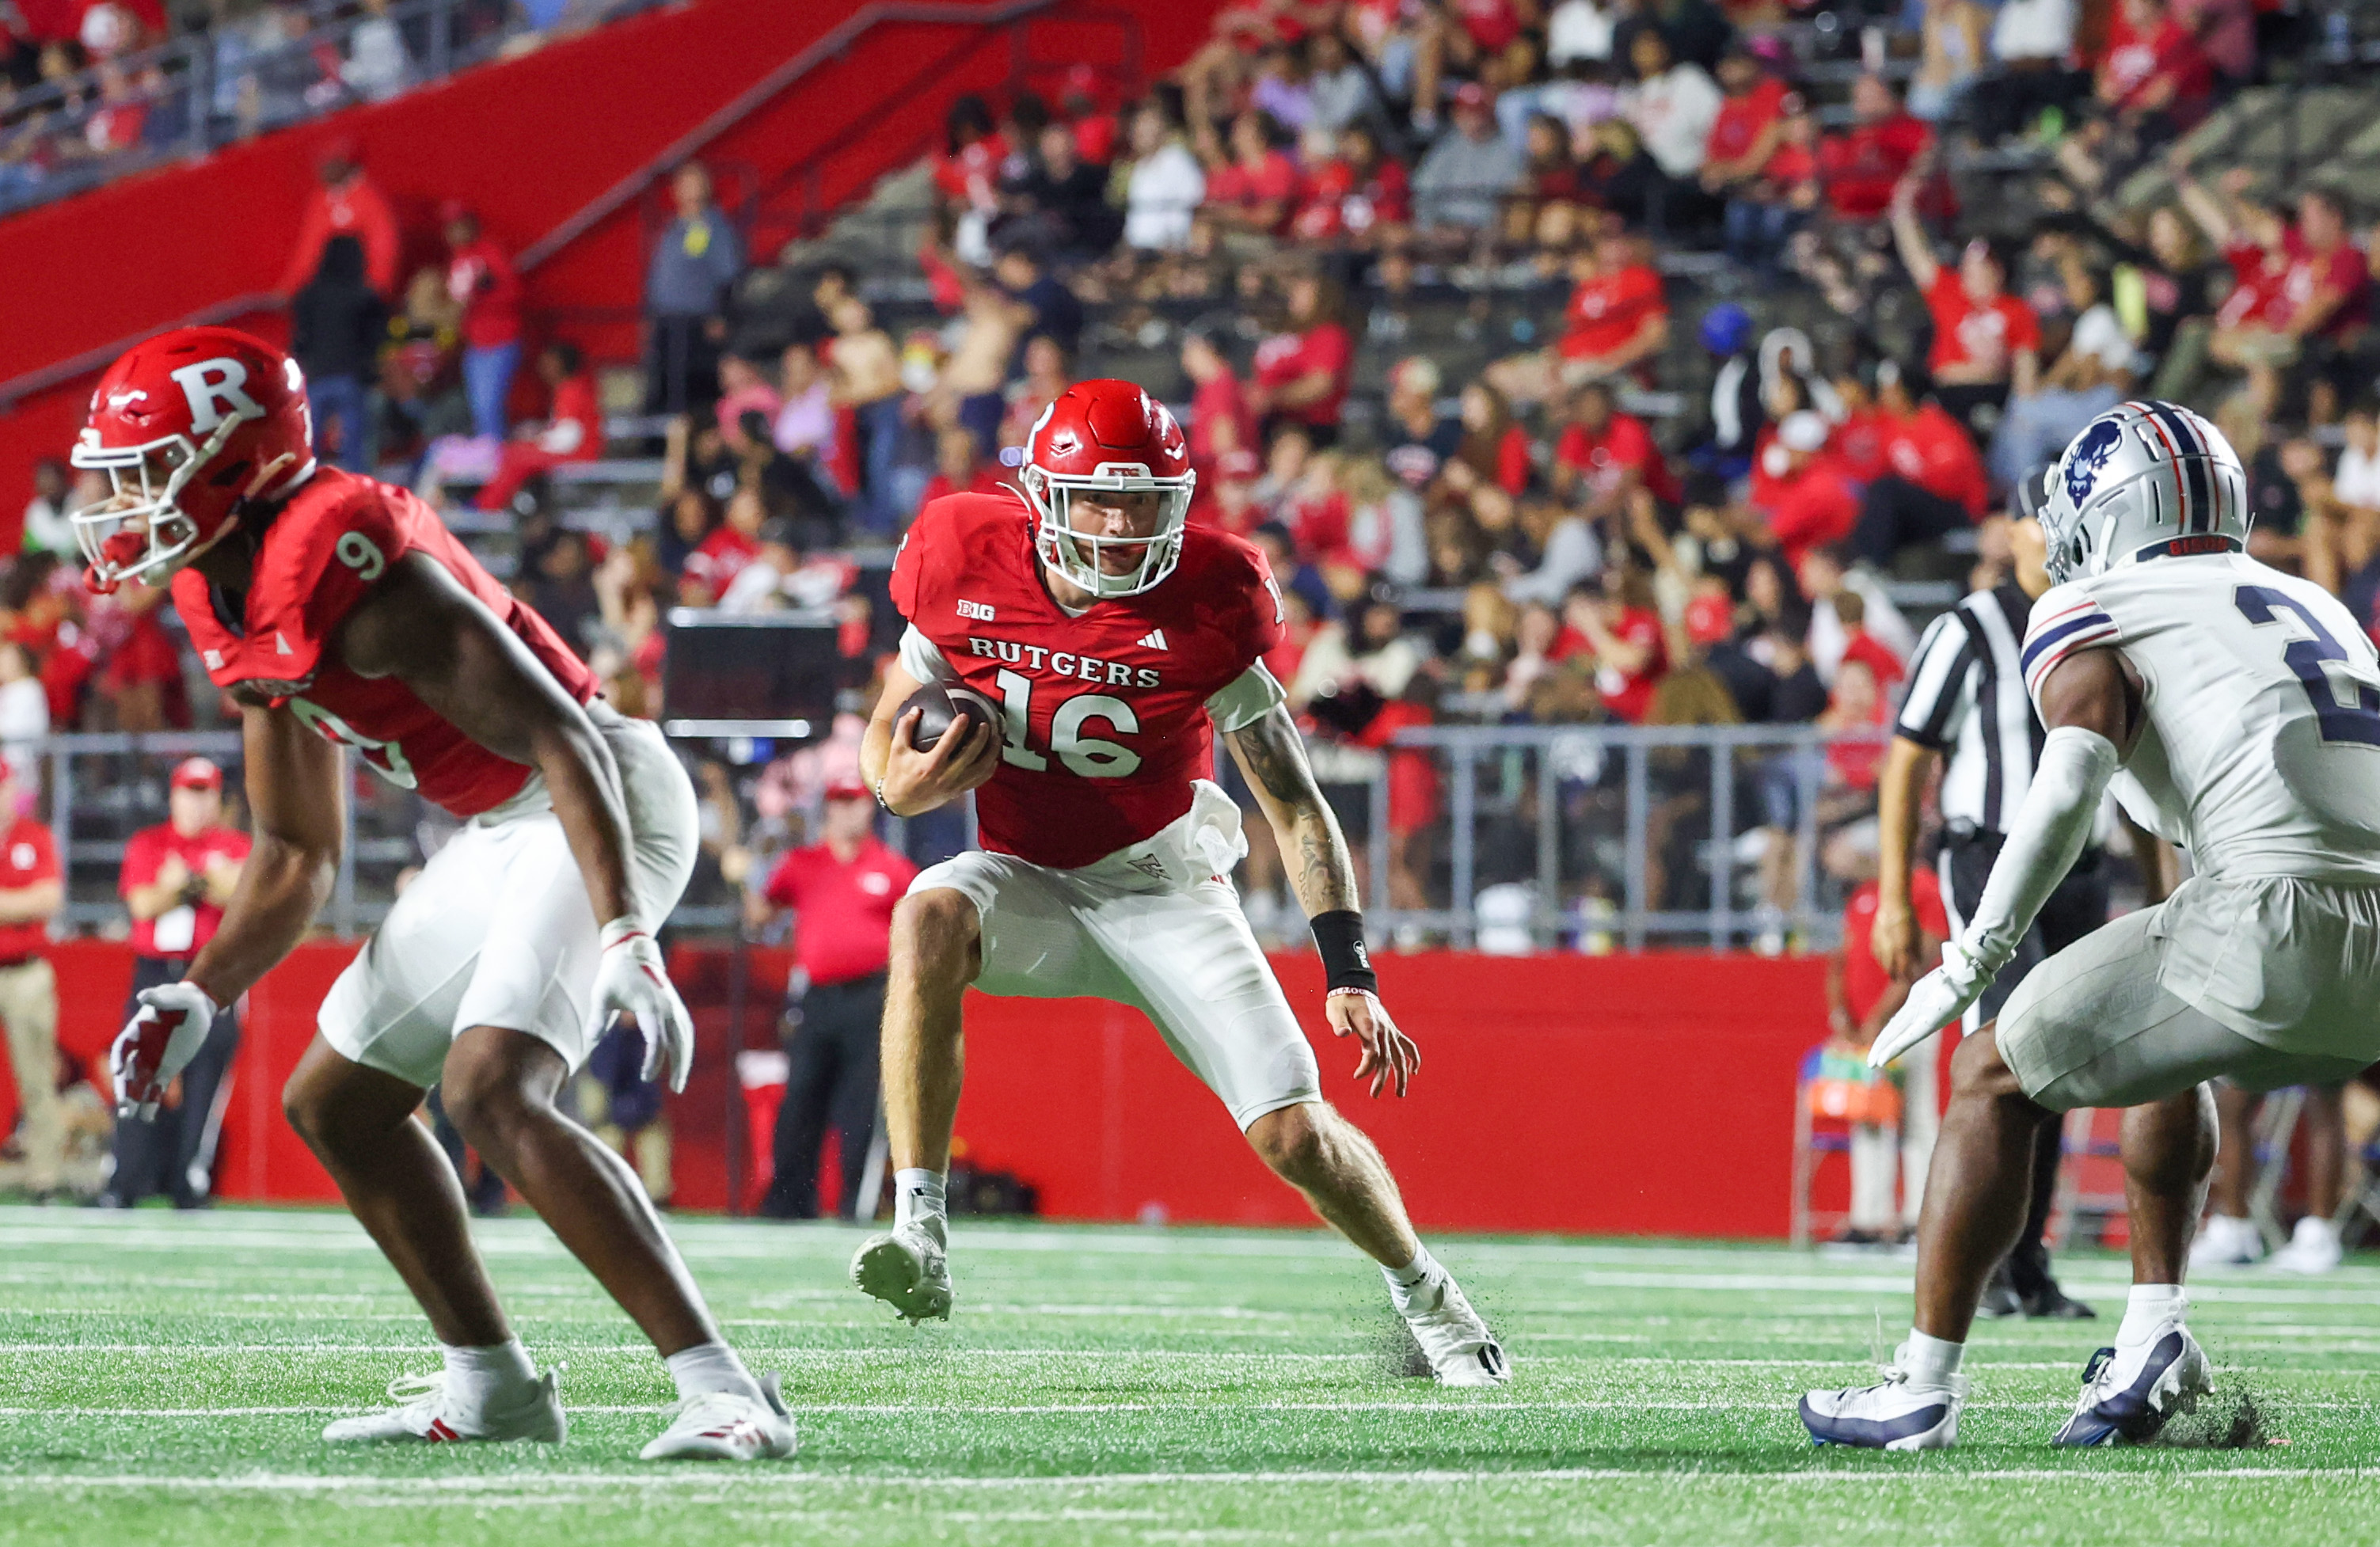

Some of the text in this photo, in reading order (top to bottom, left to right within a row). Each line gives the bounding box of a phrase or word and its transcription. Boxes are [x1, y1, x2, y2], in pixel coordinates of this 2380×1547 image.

[170, 357, 267, 435] R
[336, 530, 385, 581] 9
[968, 637, 1160, 688] RUTGERS
[2232, 583, 2380, 747] 2
[996, 667, 1142, 778] 16
